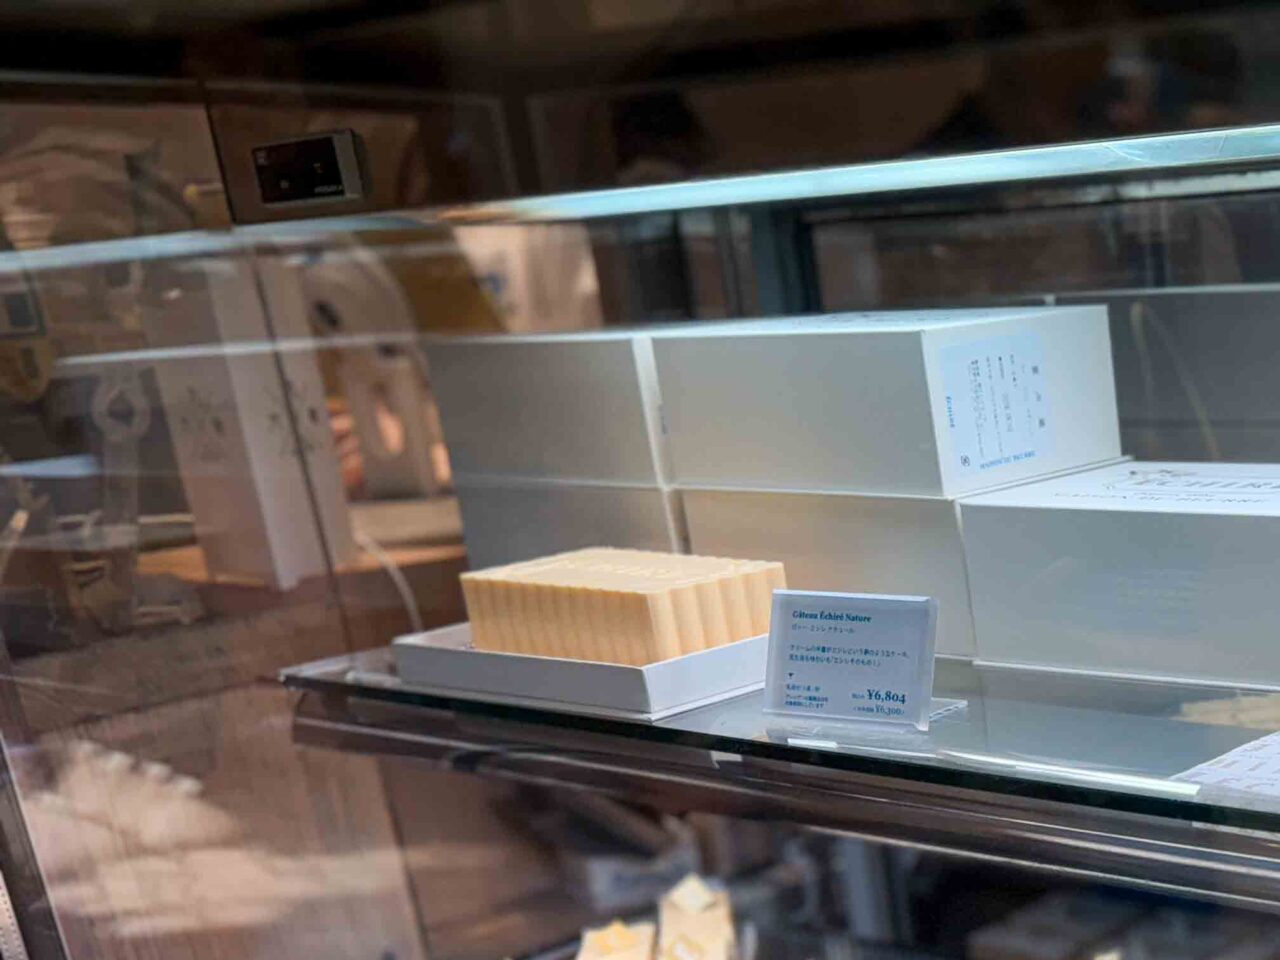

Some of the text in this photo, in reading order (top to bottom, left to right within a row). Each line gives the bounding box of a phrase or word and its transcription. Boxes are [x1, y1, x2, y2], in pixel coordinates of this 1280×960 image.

[792, 609, 872, 622] Gâteau Échiré Nature
[867, 688, 906, 705] ¥6,804
